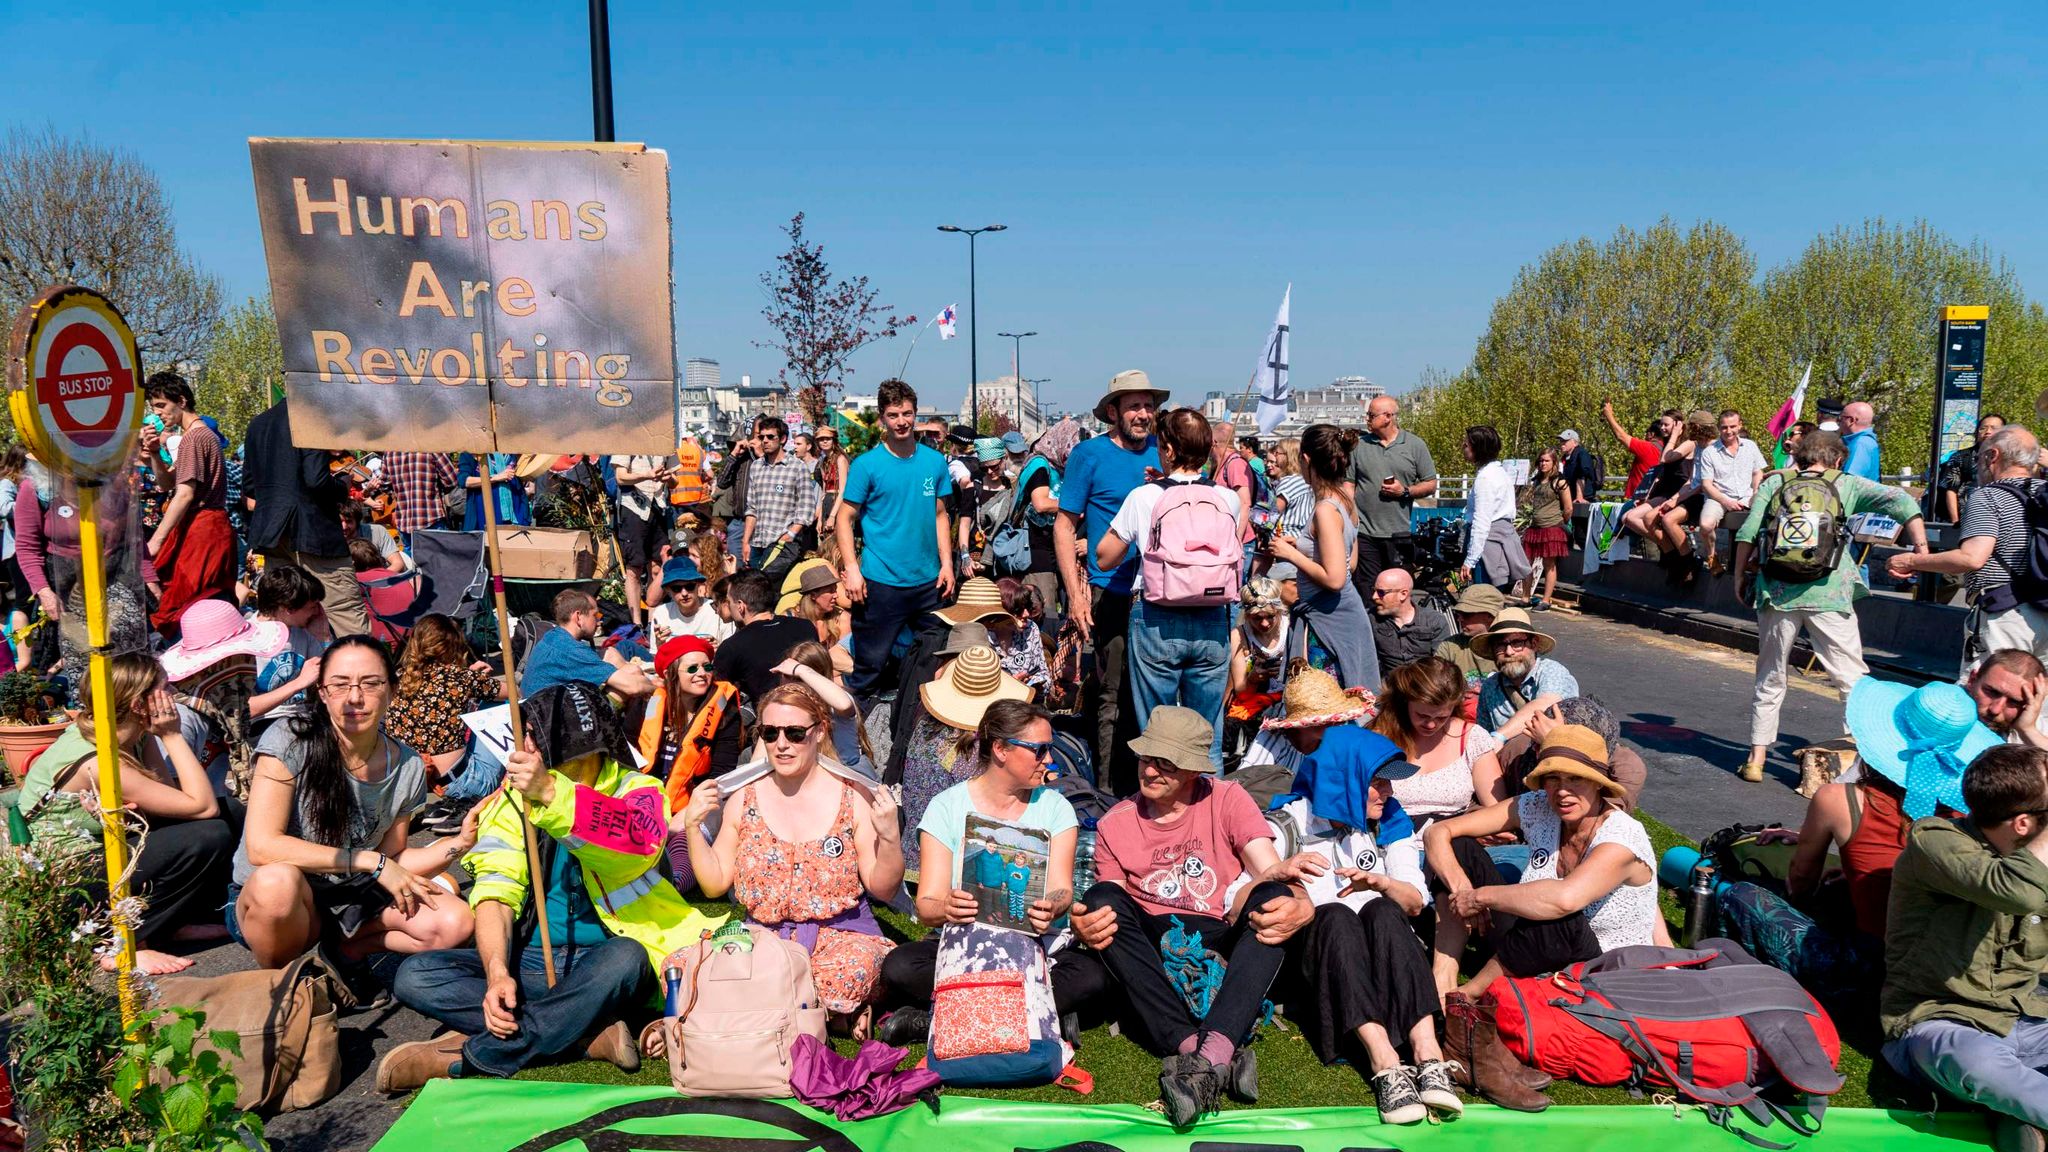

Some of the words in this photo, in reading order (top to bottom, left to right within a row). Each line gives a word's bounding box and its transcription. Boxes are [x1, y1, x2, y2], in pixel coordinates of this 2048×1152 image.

[292, 177, 608, 241] Humans
[399, 261, 537, 318] Are
[311, 330, 633, 408] Revolting
[58, 380, 82, 396] BUS
[84, 376, 113, 393] STOP
[588, 801, 603, 833] TRUTH
[601, 811, 612, 828] THE
[607, 810, 628, 838] TELL
